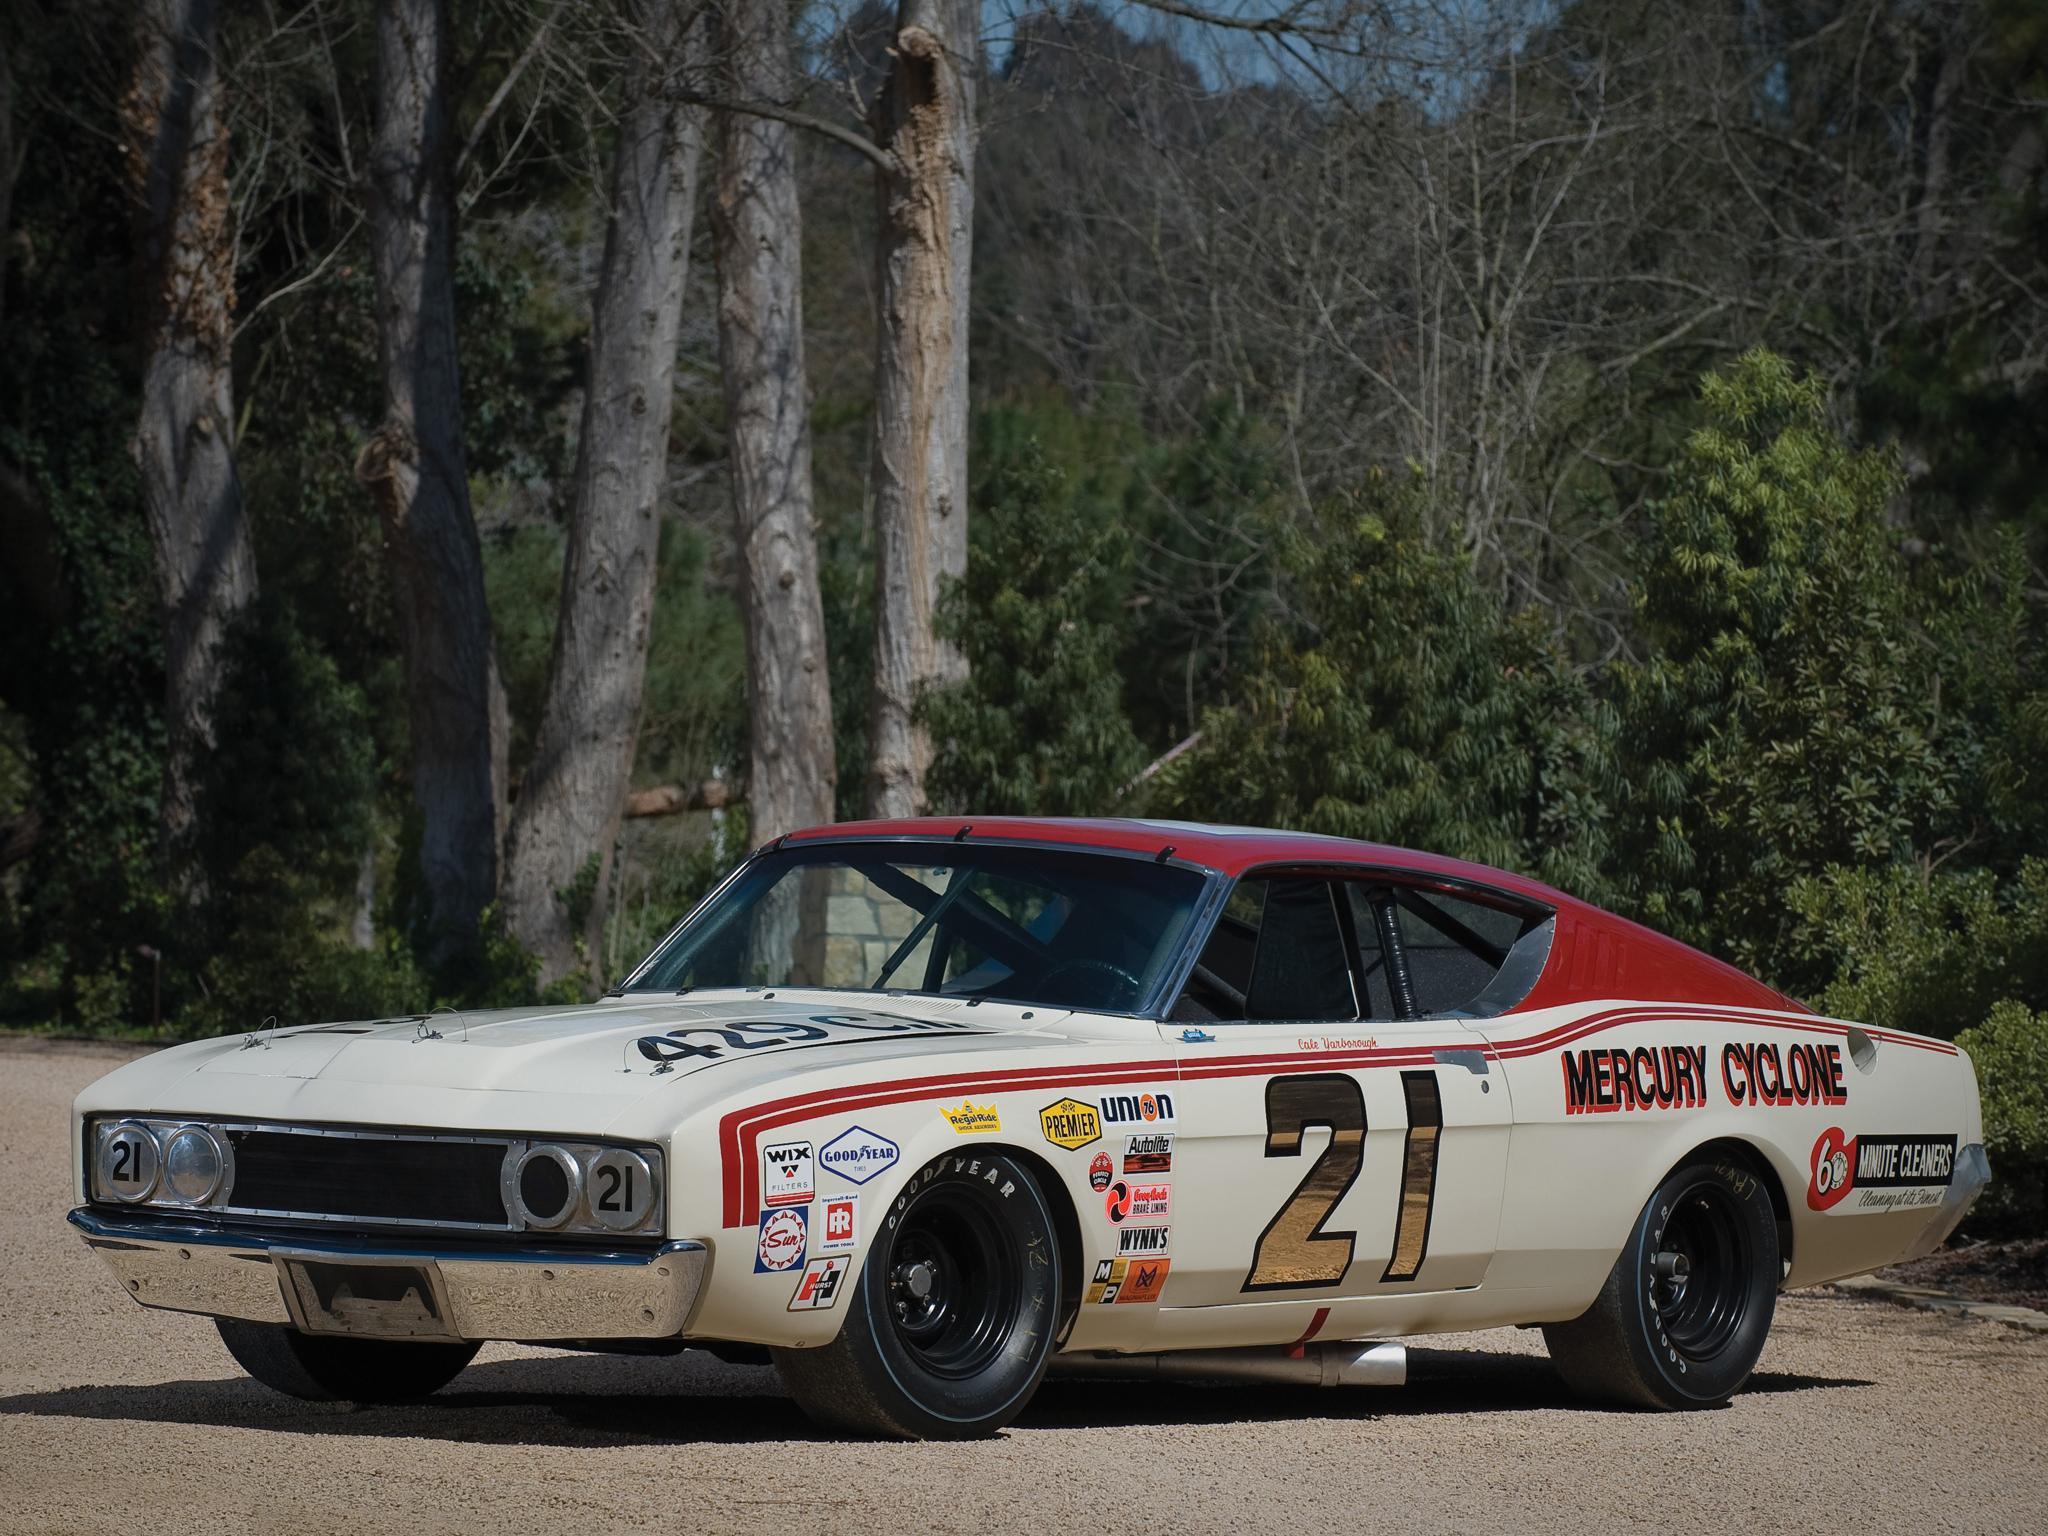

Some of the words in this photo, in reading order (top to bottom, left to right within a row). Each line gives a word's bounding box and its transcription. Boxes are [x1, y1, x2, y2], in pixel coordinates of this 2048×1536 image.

[637, 1021, 828, 1062] 429
[1298, 1039, 1319, 1050] Cale
[1321, 1036, 1379, 1052] Yarborough
[1561, 1046, 1707, 1115] MERCURY
[1721, 1043, 1848, 1106] CYCLONE
[1143, 1101, 1154, 1115] 76
[1046, 1113, 1097, 1139] PREMIER
[767, 1147, 811, 1162] WIX
[825, 1145, 894, 1162] GOODYEAR
[1129, 1136, 1170, 1154] Autolite
[112, 1141, 141, 1182] 21
[1858, 1145, 1898, 1178] MINUTE
[1900, 1144, 1953, 1177] CLEANERS
[597, 1165, 633, 1212] 21
[772, 1182, 808, 1191] FILTERS
[1240, 1070, 1443, 1293] 21
[1133, 1203, 1150, 1214] BRAKE
[1151, 1202, 1167, 1213] LINING
[767, 1229, 798, 1248] Sun
[1120, 1227, 1168, 1250] WYNN'S
[809, 1281, 832, 1289] HURST
